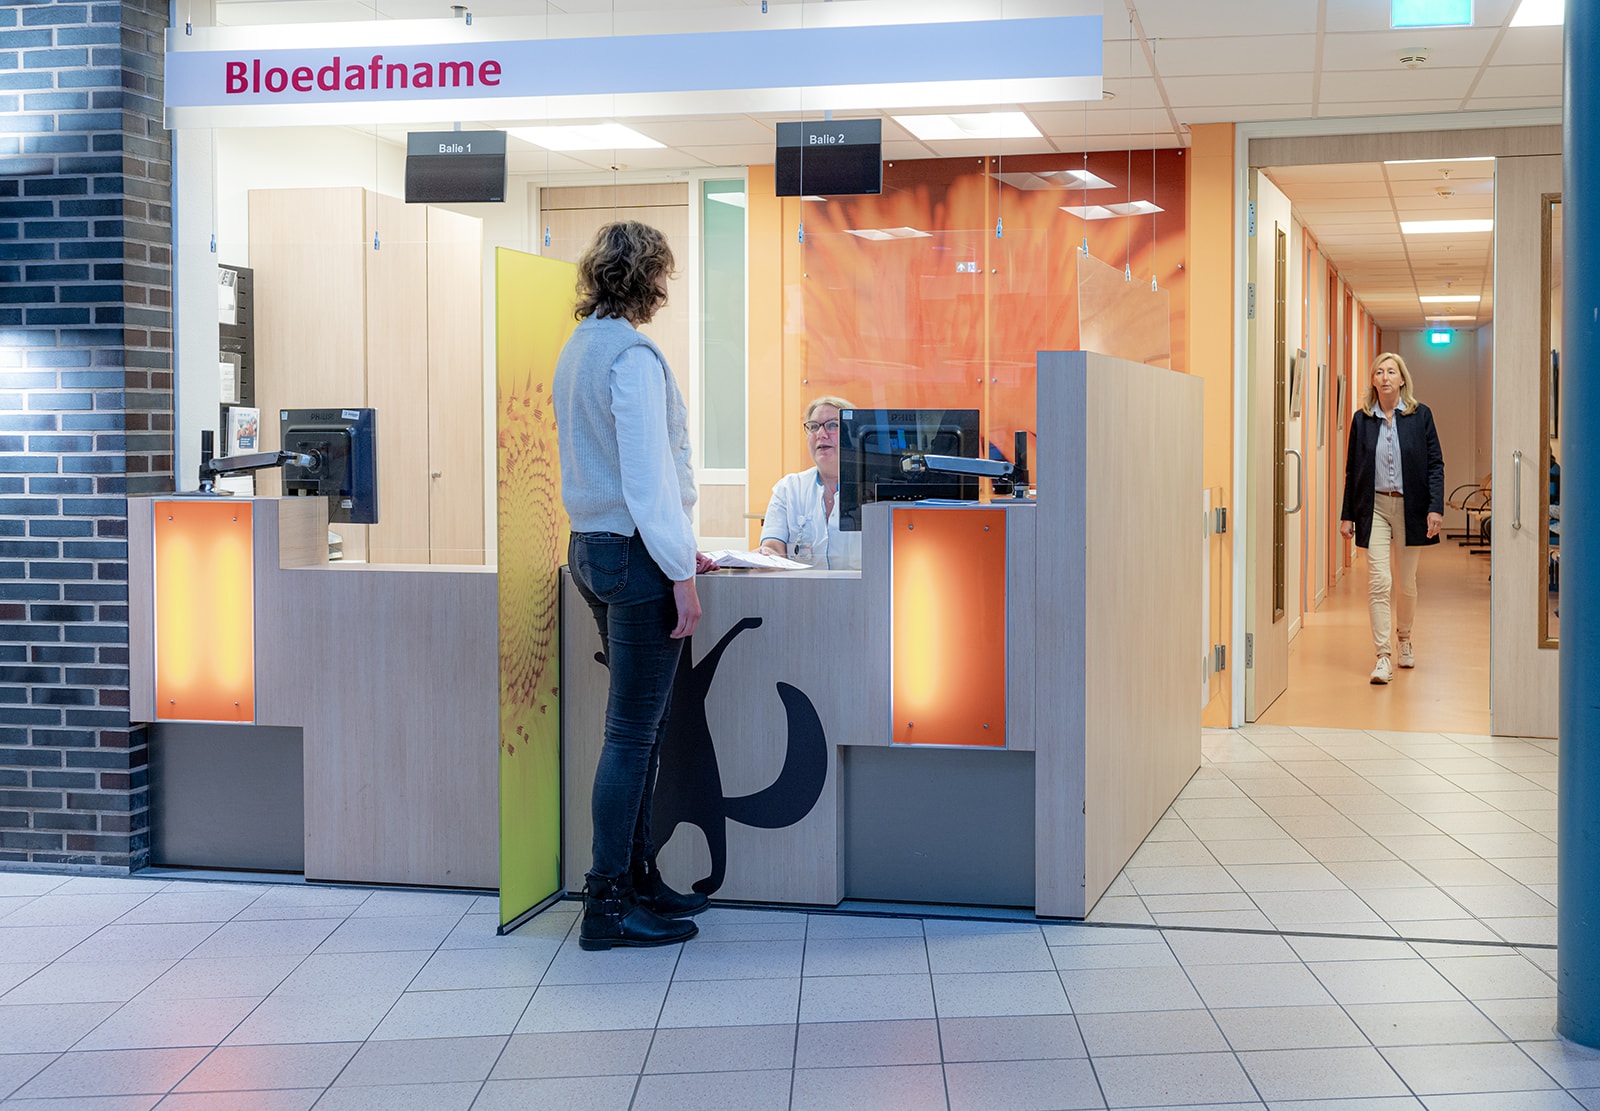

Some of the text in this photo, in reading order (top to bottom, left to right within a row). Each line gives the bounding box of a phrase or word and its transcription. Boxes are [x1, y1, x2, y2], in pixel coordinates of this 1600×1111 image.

[225, 55, 502, 94] Bloedafname
[809, 133, 845, 144] Balie 2
[439, 143, 472, 153] Balie 1
[891, 414, 929, 422] PHILIPS
